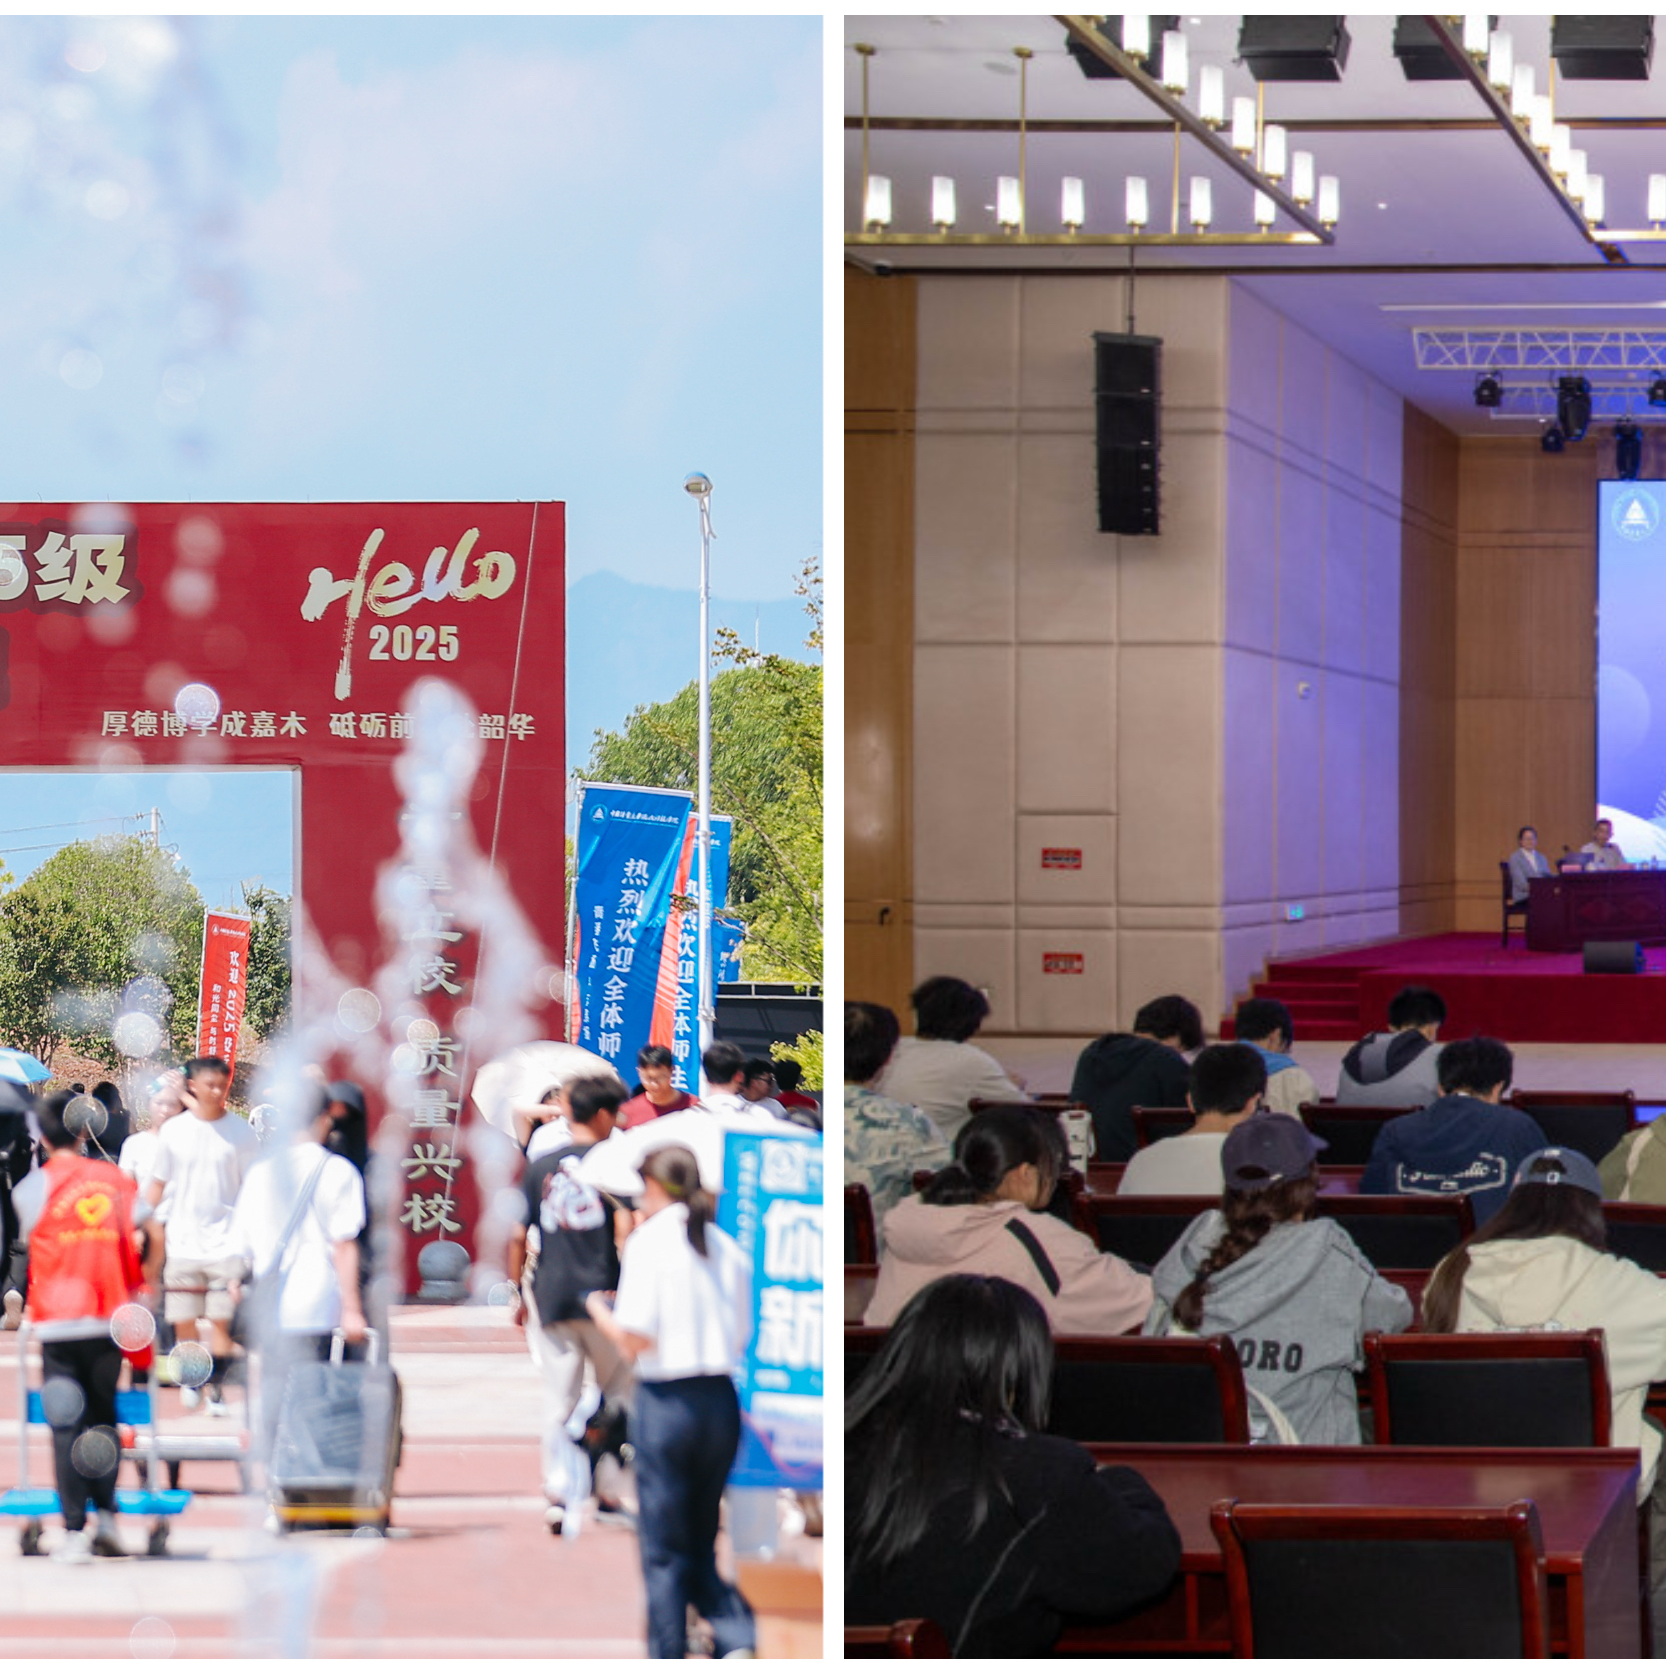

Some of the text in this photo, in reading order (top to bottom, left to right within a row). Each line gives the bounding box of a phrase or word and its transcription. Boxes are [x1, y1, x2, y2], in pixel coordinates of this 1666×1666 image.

[299, 526, 518, 702] Hello
[368, 624, 460, 662] 2025
[101, 709, 537, 741] 厚德博学成嘉木 砥砺前韶华
